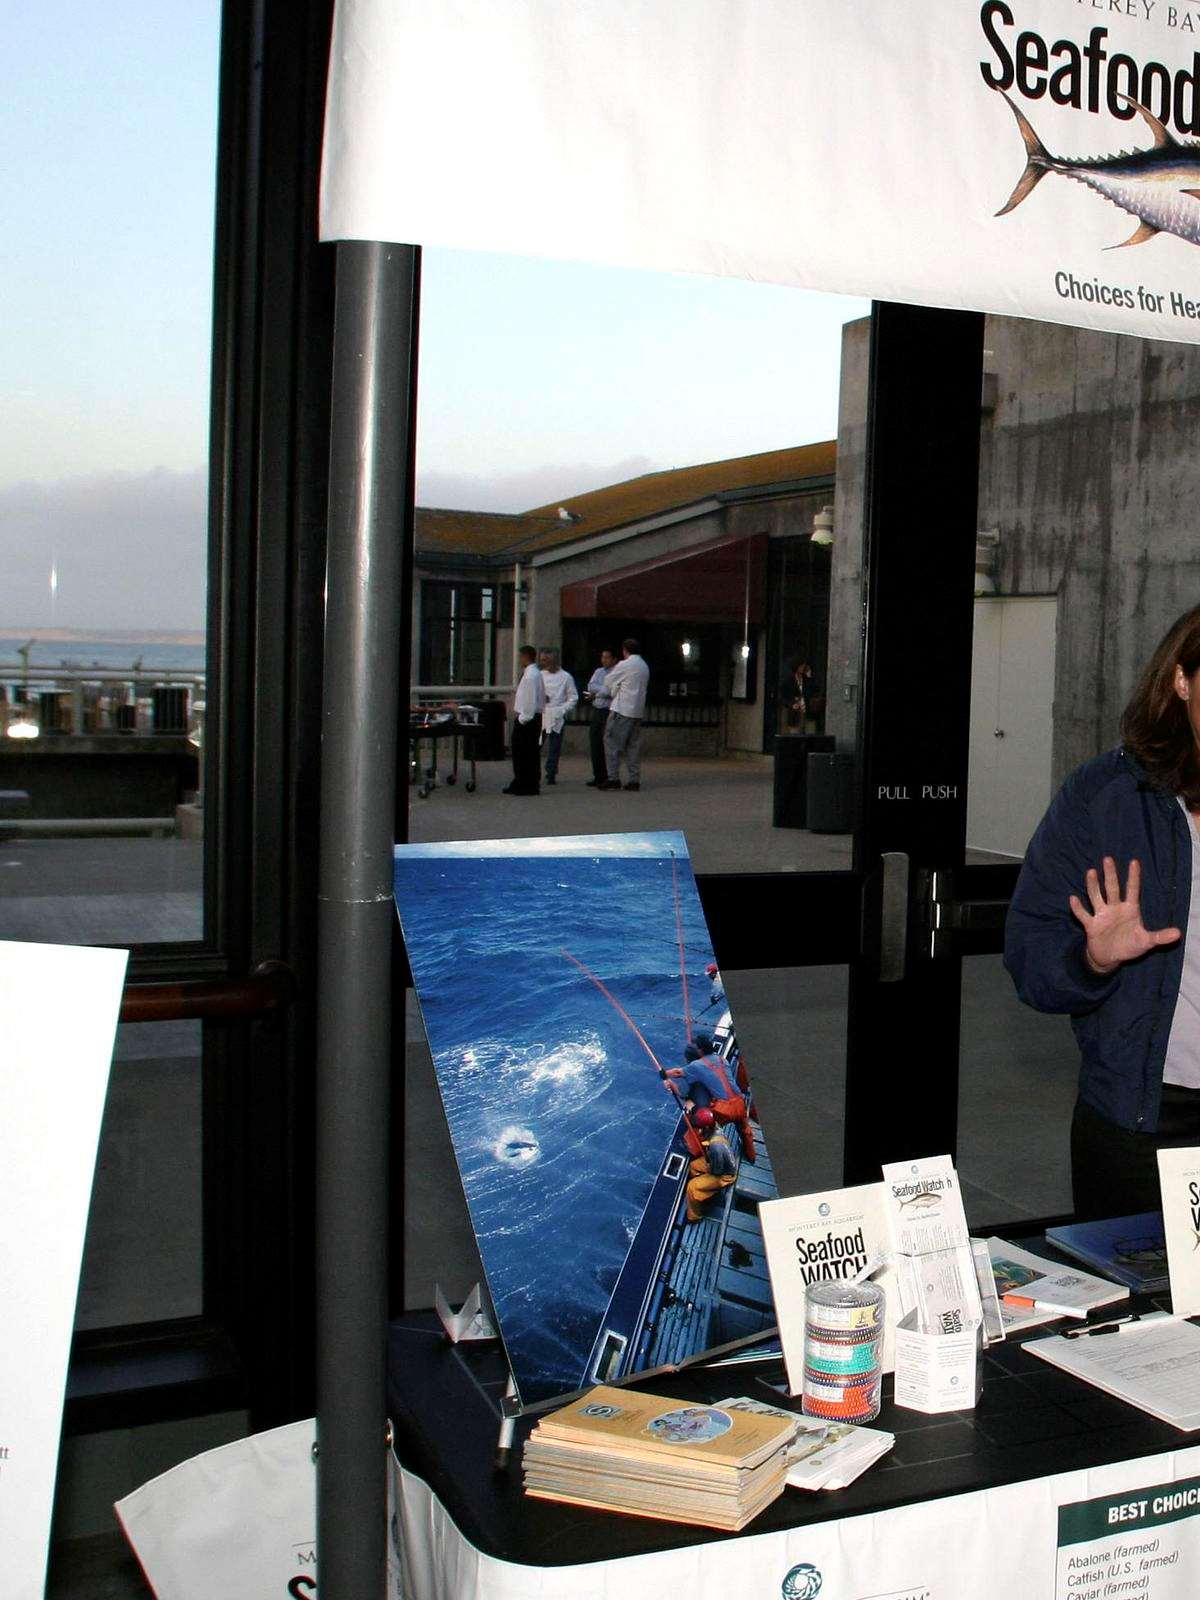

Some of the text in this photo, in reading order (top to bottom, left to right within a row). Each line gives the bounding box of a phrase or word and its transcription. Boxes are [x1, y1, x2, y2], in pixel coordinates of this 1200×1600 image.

[1054, 271, 1135, 310] Choices
[1137, 285, 1165, 312] for
[878, 785, 957, 800] PULL PUSH
[892, 1181, 922, 1198] Seafood
[796, 1227, 866, 1265] Seafood
[1107, 1500, 1148, 1524] BEST
[1067, 1538, 1160, 1570] Abalone (farmed)
[1067, 1550, 1179, 1587] Catfish (U.S. farmed)
[1103, 1575, 1150, 1597] (farmed)
